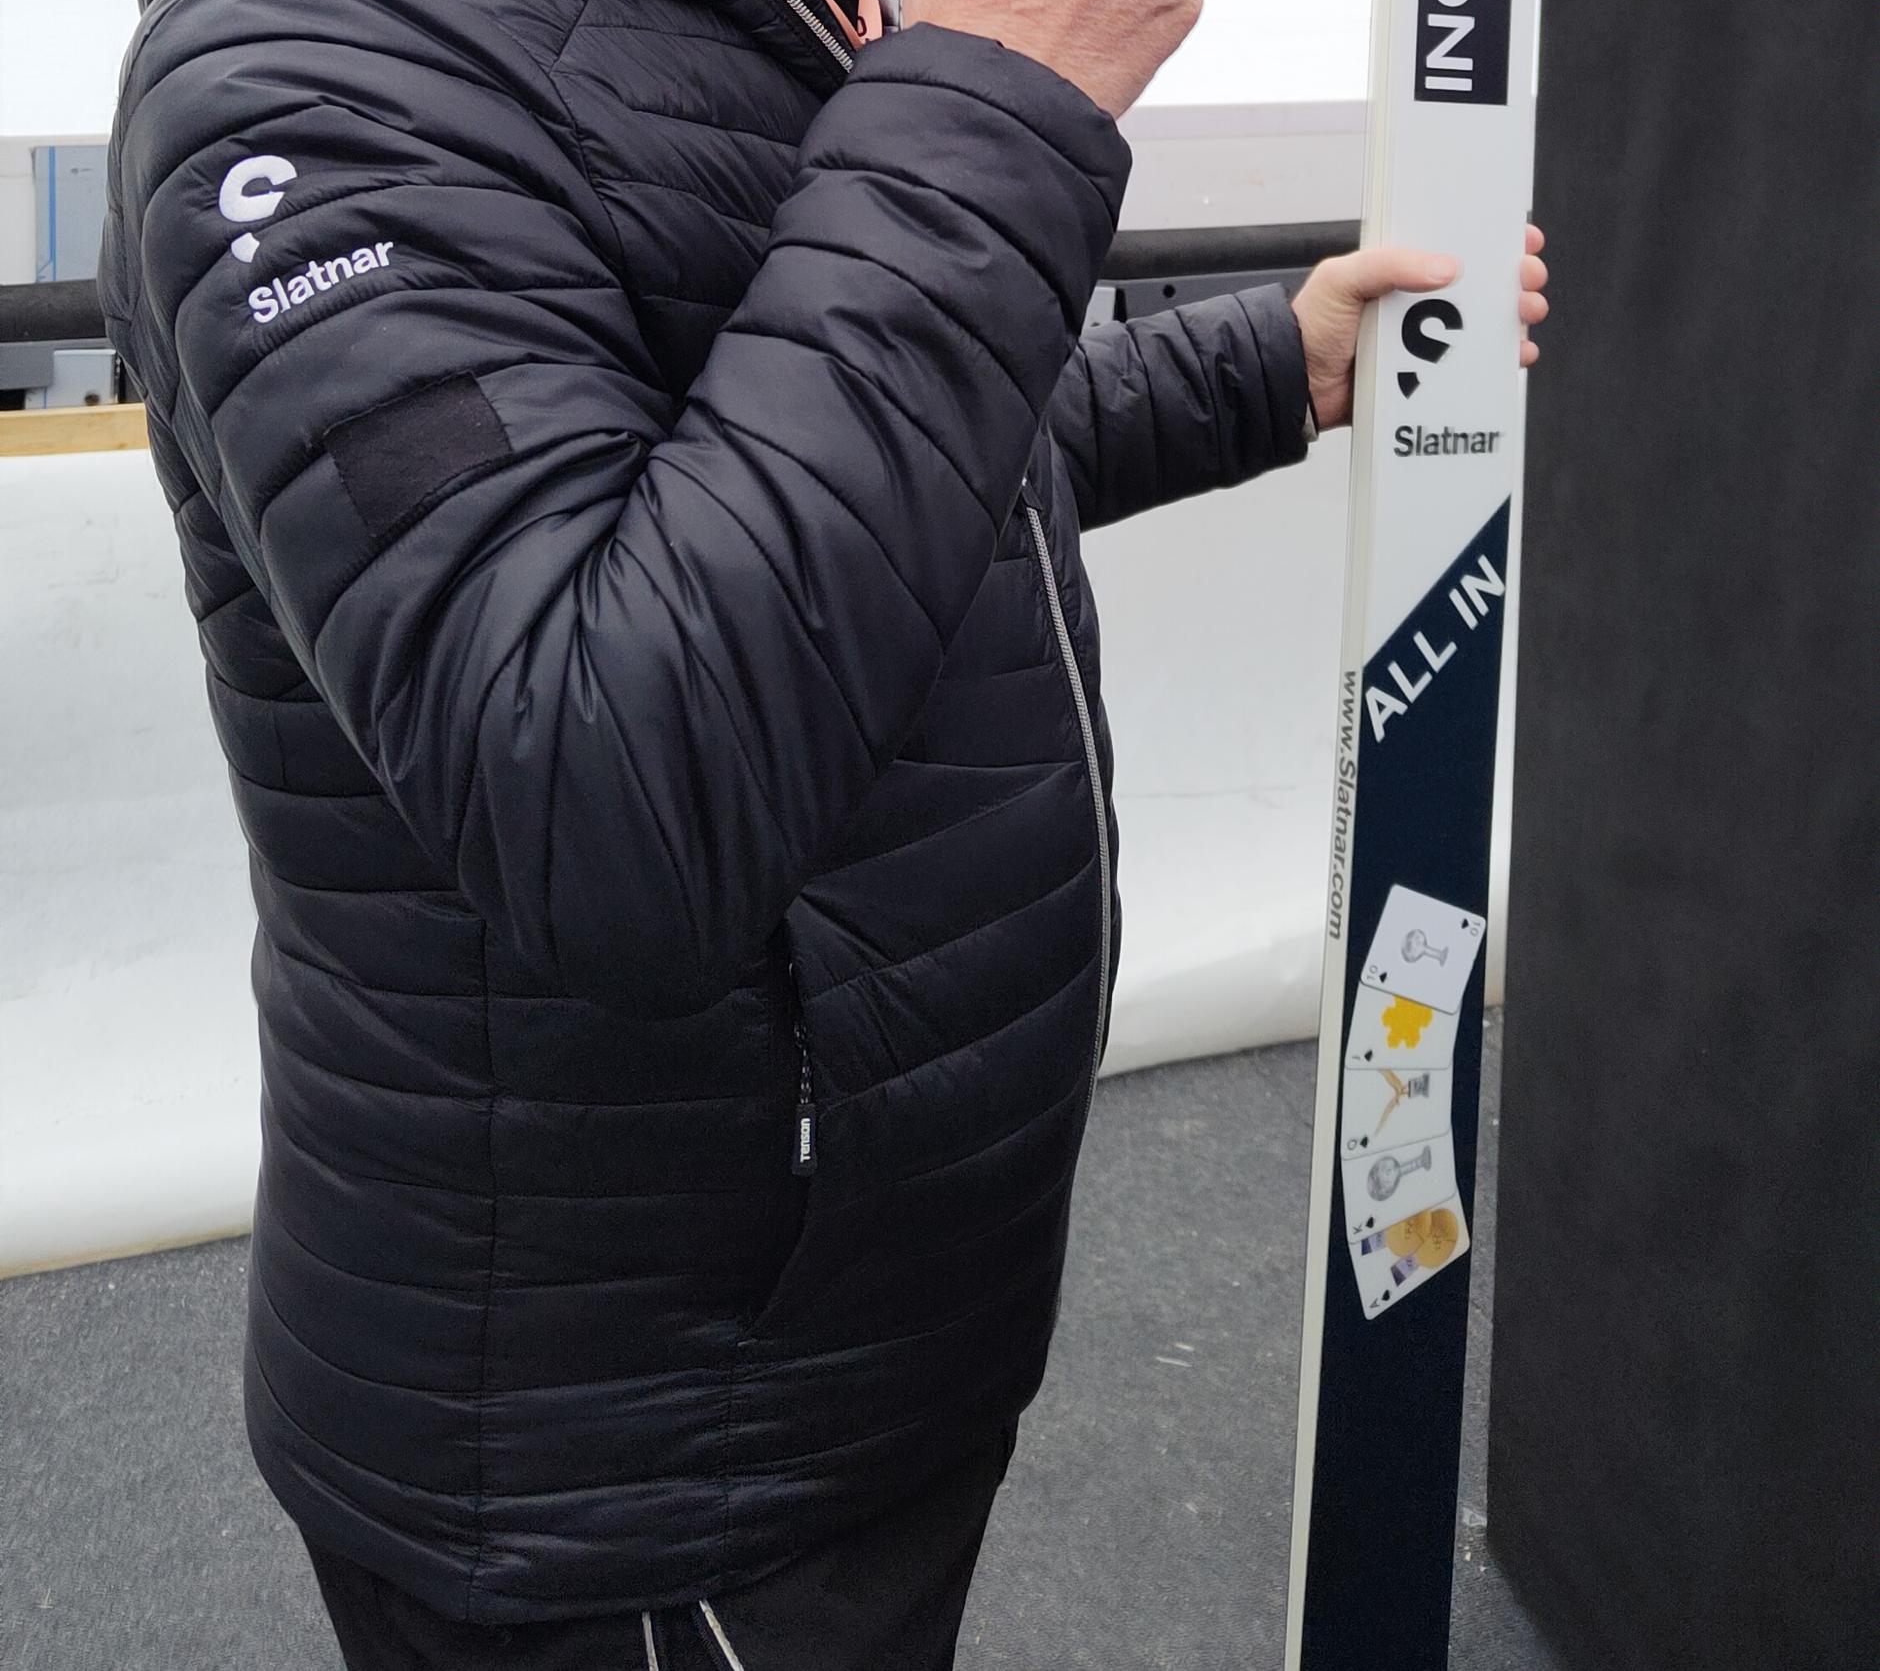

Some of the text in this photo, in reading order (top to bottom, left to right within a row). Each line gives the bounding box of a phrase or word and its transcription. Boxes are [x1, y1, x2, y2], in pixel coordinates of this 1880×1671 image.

[248, 241, 394, 324] Slatnar
[1393, 425, 1500, 457] Slatnar
[1365, 554, 1505, 744] ALL IN
[1329, 670, 1357, 941] www.Slatnar.com
